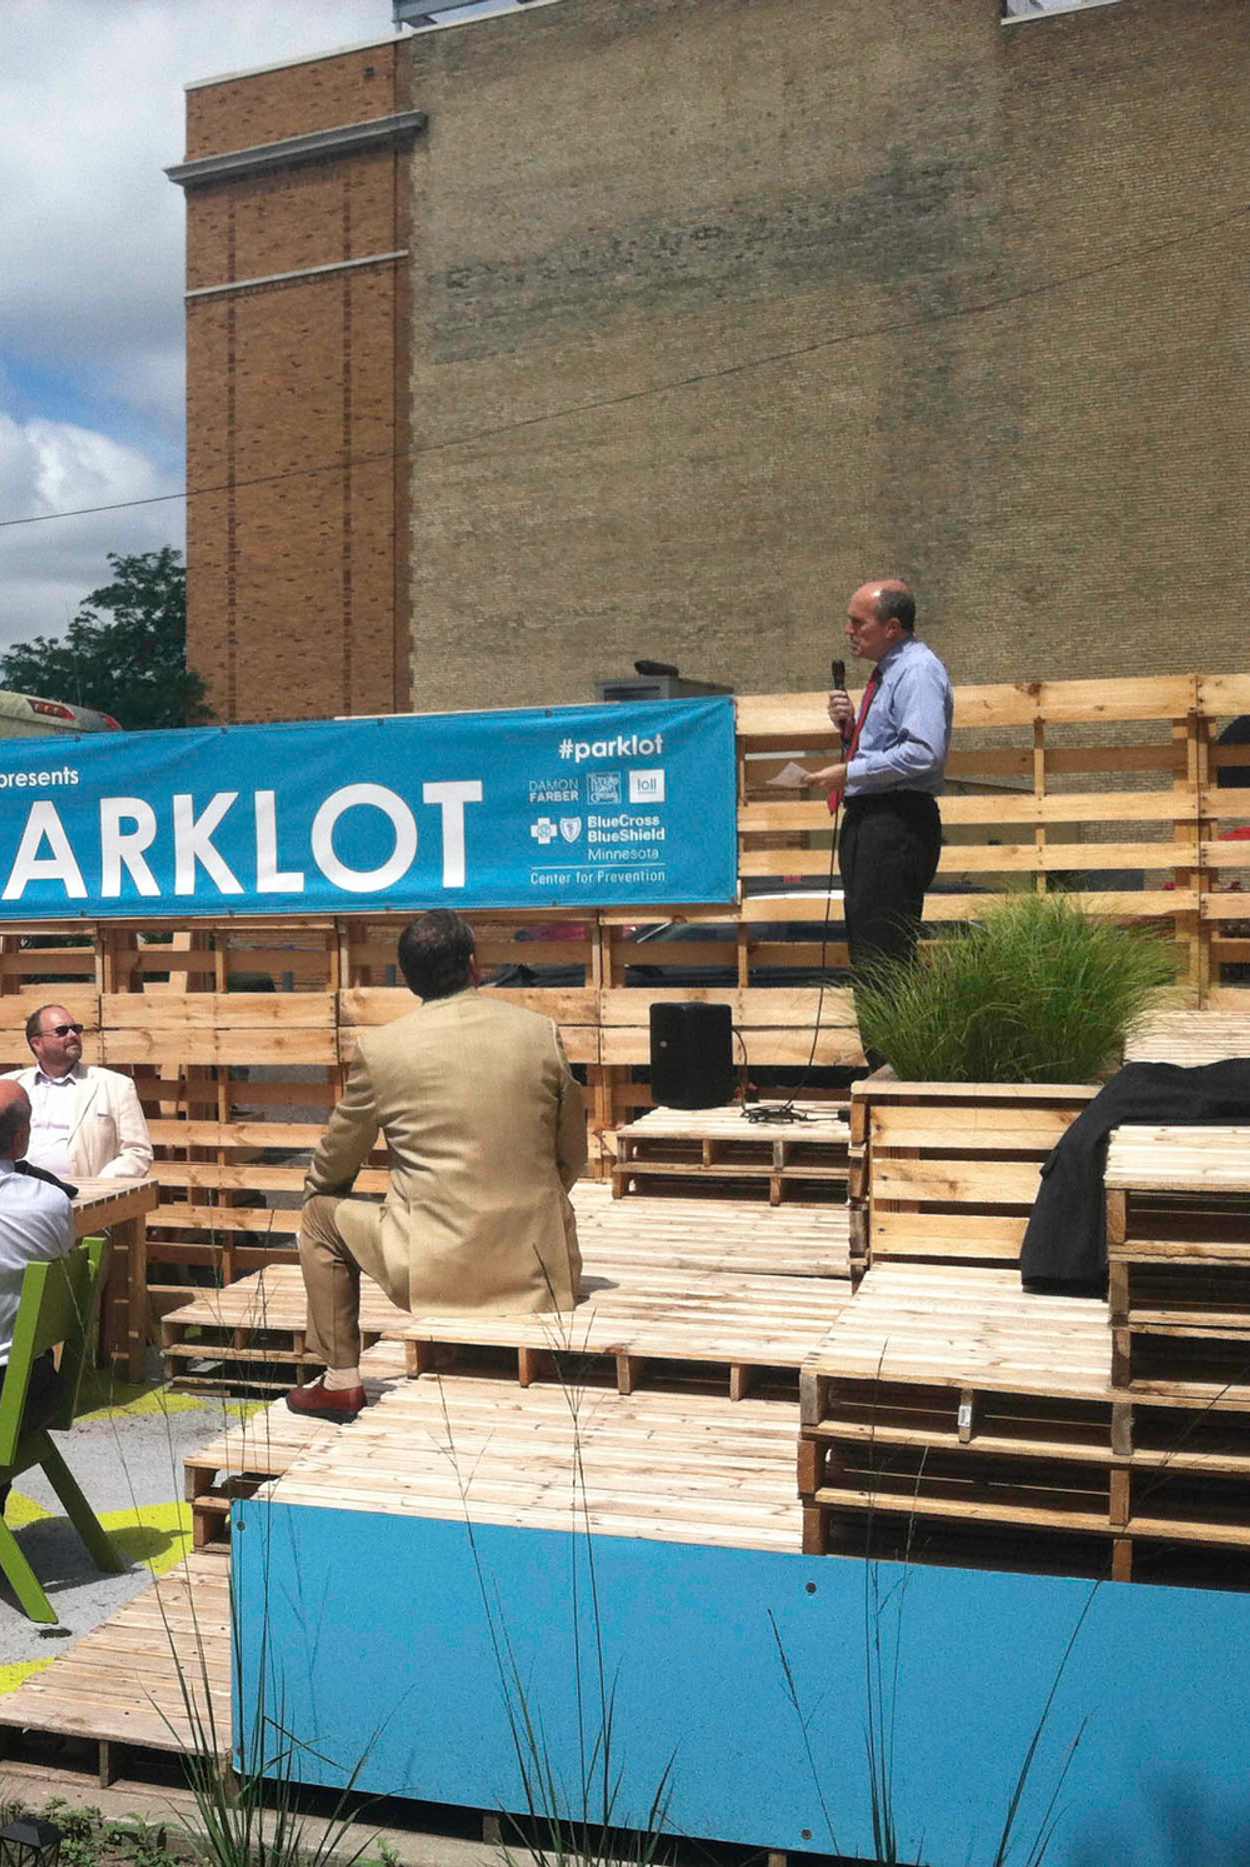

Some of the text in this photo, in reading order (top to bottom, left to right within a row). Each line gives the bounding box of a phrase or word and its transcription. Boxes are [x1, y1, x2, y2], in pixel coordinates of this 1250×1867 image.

[559, 734, 663, 763] #parklot
[528, 778, 579, 791] DAMON
[529, 790, 579, 803] FARBER
[587, 814, 660, 828] BlueCross
[587, 828, 666, 843] BlueShield
[588, 848, 660, 861] Minnesota
[530, 870, 665, 885] Center for Prevention
